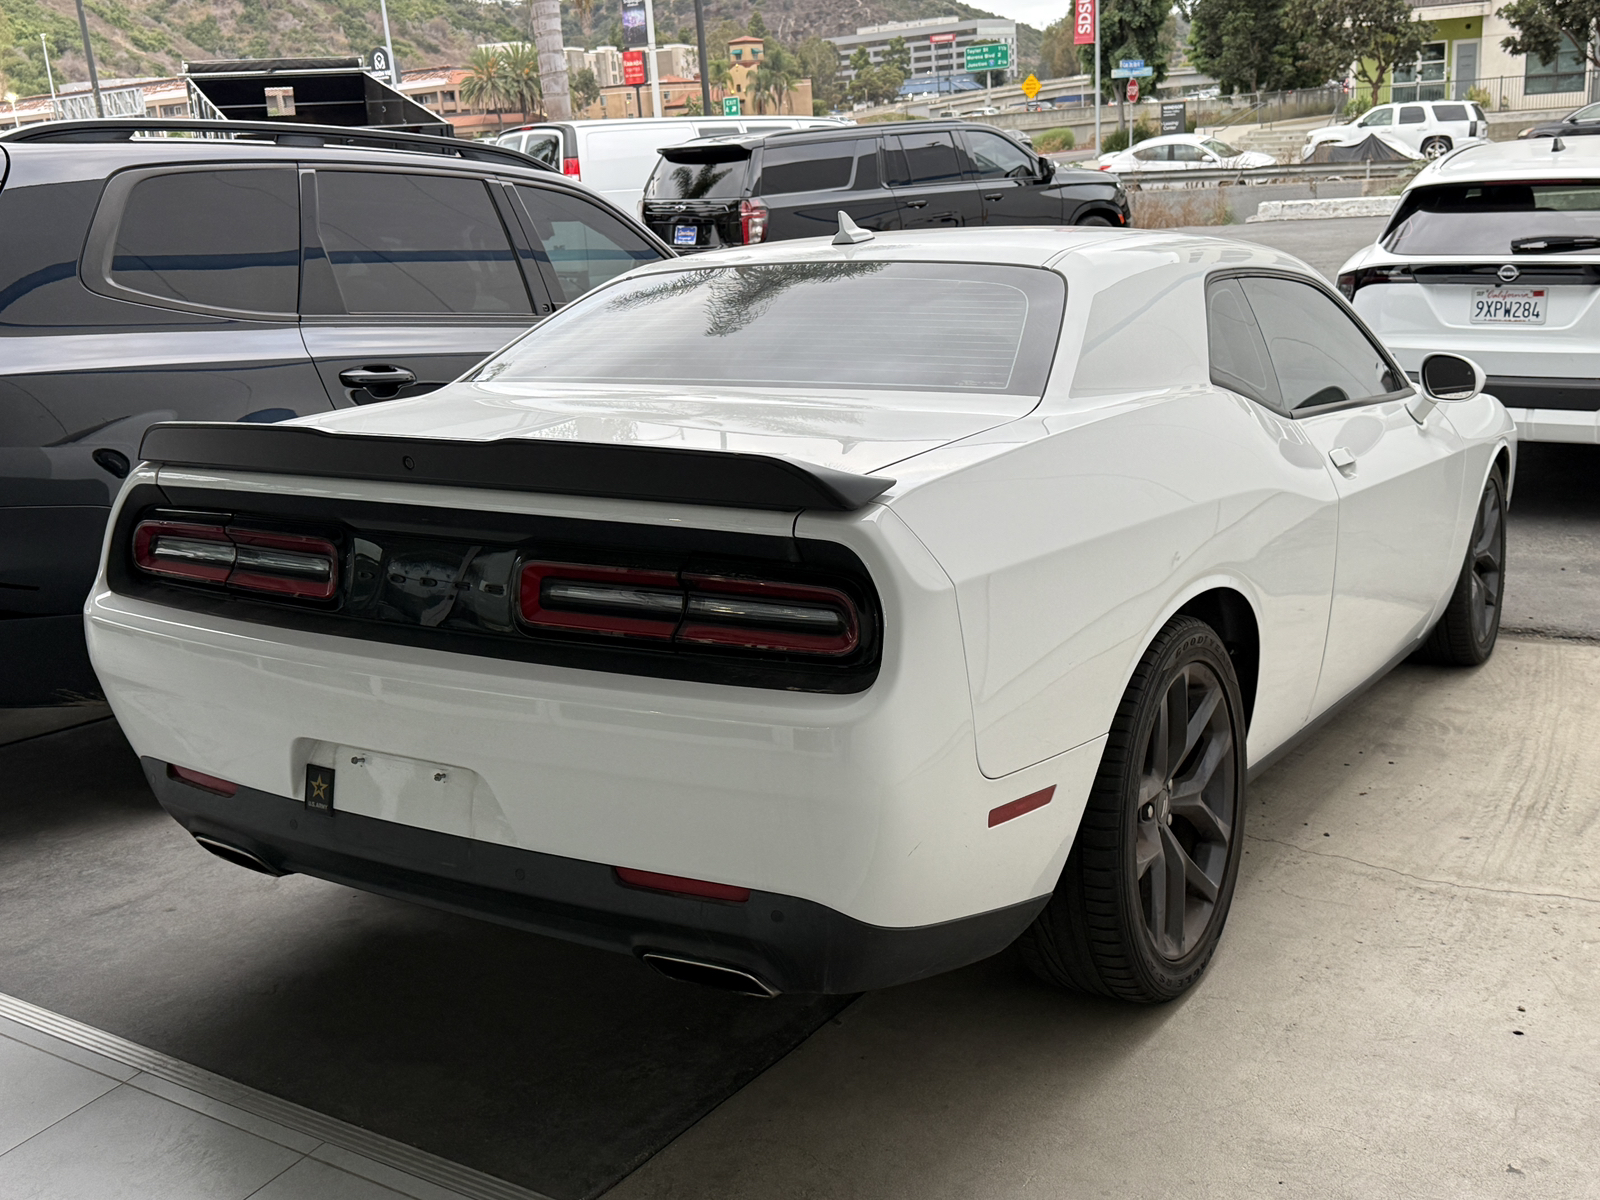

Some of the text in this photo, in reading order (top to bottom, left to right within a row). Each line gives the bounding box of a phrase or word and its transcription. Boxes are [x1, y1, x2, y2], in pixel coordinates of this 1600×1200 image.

[1078, 0, 1092, 34] SDS
[1128, 86, 1138, 96] STOP
[1487, 290, 1533, 300] California
[1475, 301, 1540, 318] 9XPW284
[1175, 635, 1232, 671] GOODYEAR
